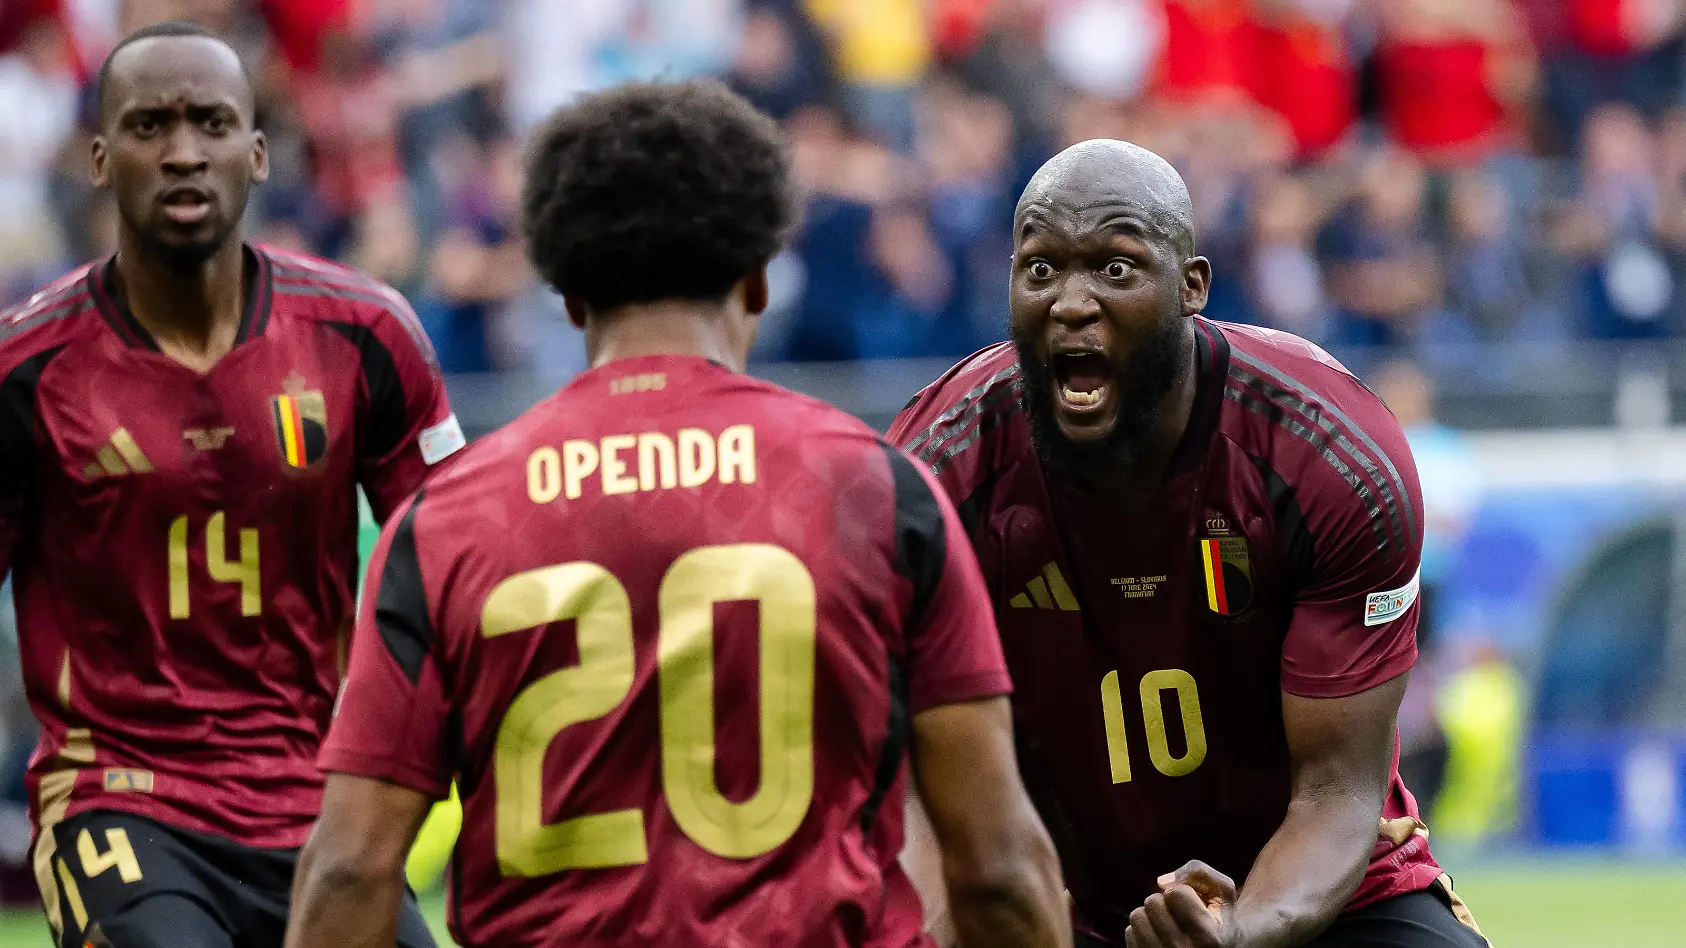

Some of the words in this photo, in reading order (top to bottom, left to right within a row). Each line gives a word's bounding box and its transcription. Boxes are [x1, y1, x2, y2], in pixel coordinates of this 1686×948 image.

[527, 424, 756, 504] OPENDA
[168, 510, 262, 619] 14
[1369, 594, 1390, 603] UEFA
[481, 543, 816, 879] 20
[1100, 668, 1207, 784] 10
[57, 827, 143, 933] 14
